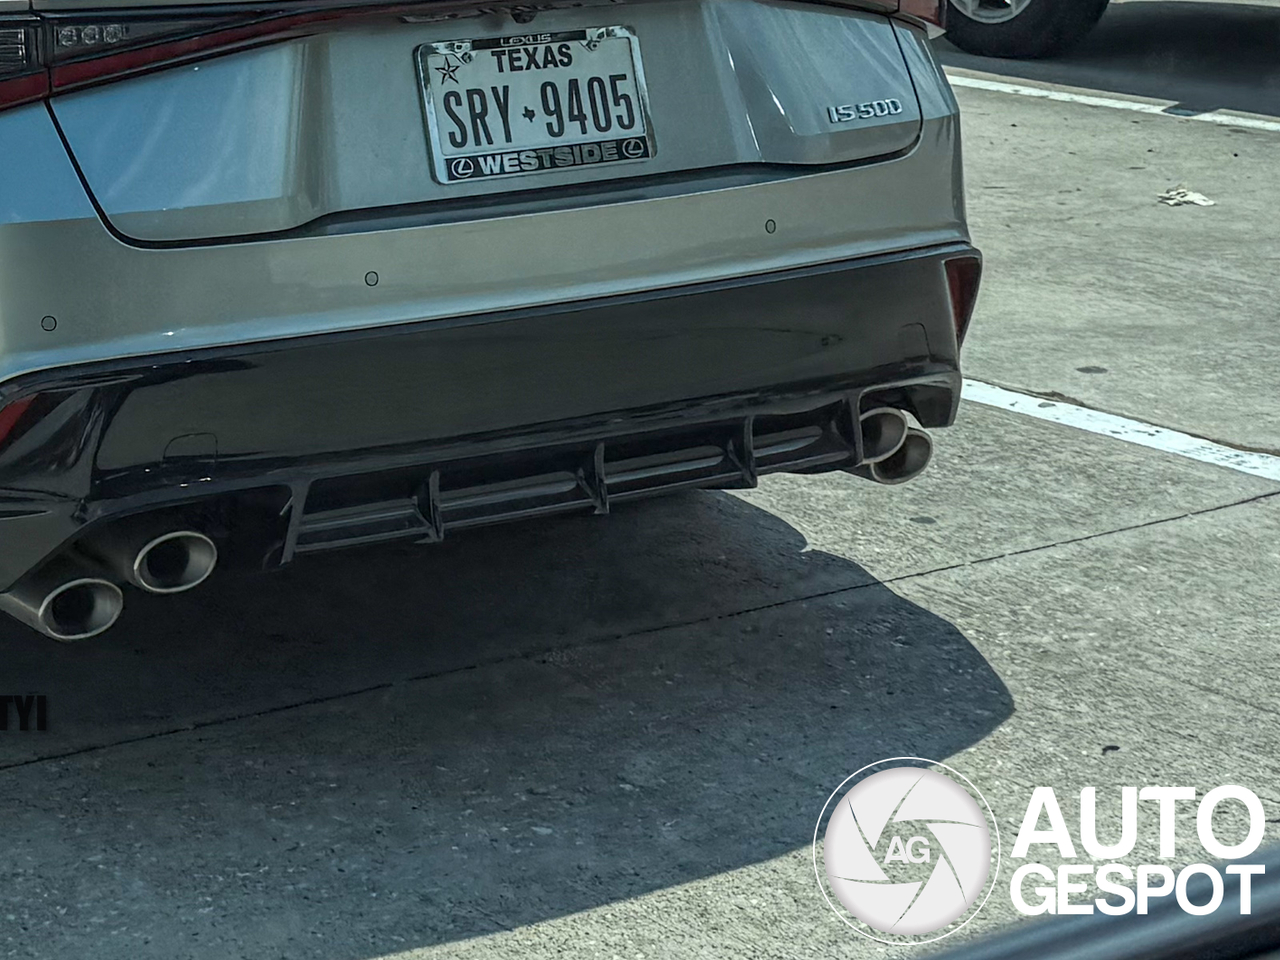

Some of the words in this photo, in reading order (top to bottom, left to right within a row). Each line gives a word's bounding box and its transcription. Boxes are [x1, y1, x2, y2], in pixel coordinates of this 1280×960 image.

[491, 43, 573, 73] TEXAS
[443, 85, 513, 149] SRY
[540, 73, 635, 138] 9405
[477, 141, 619, 175] WESTSIDE
